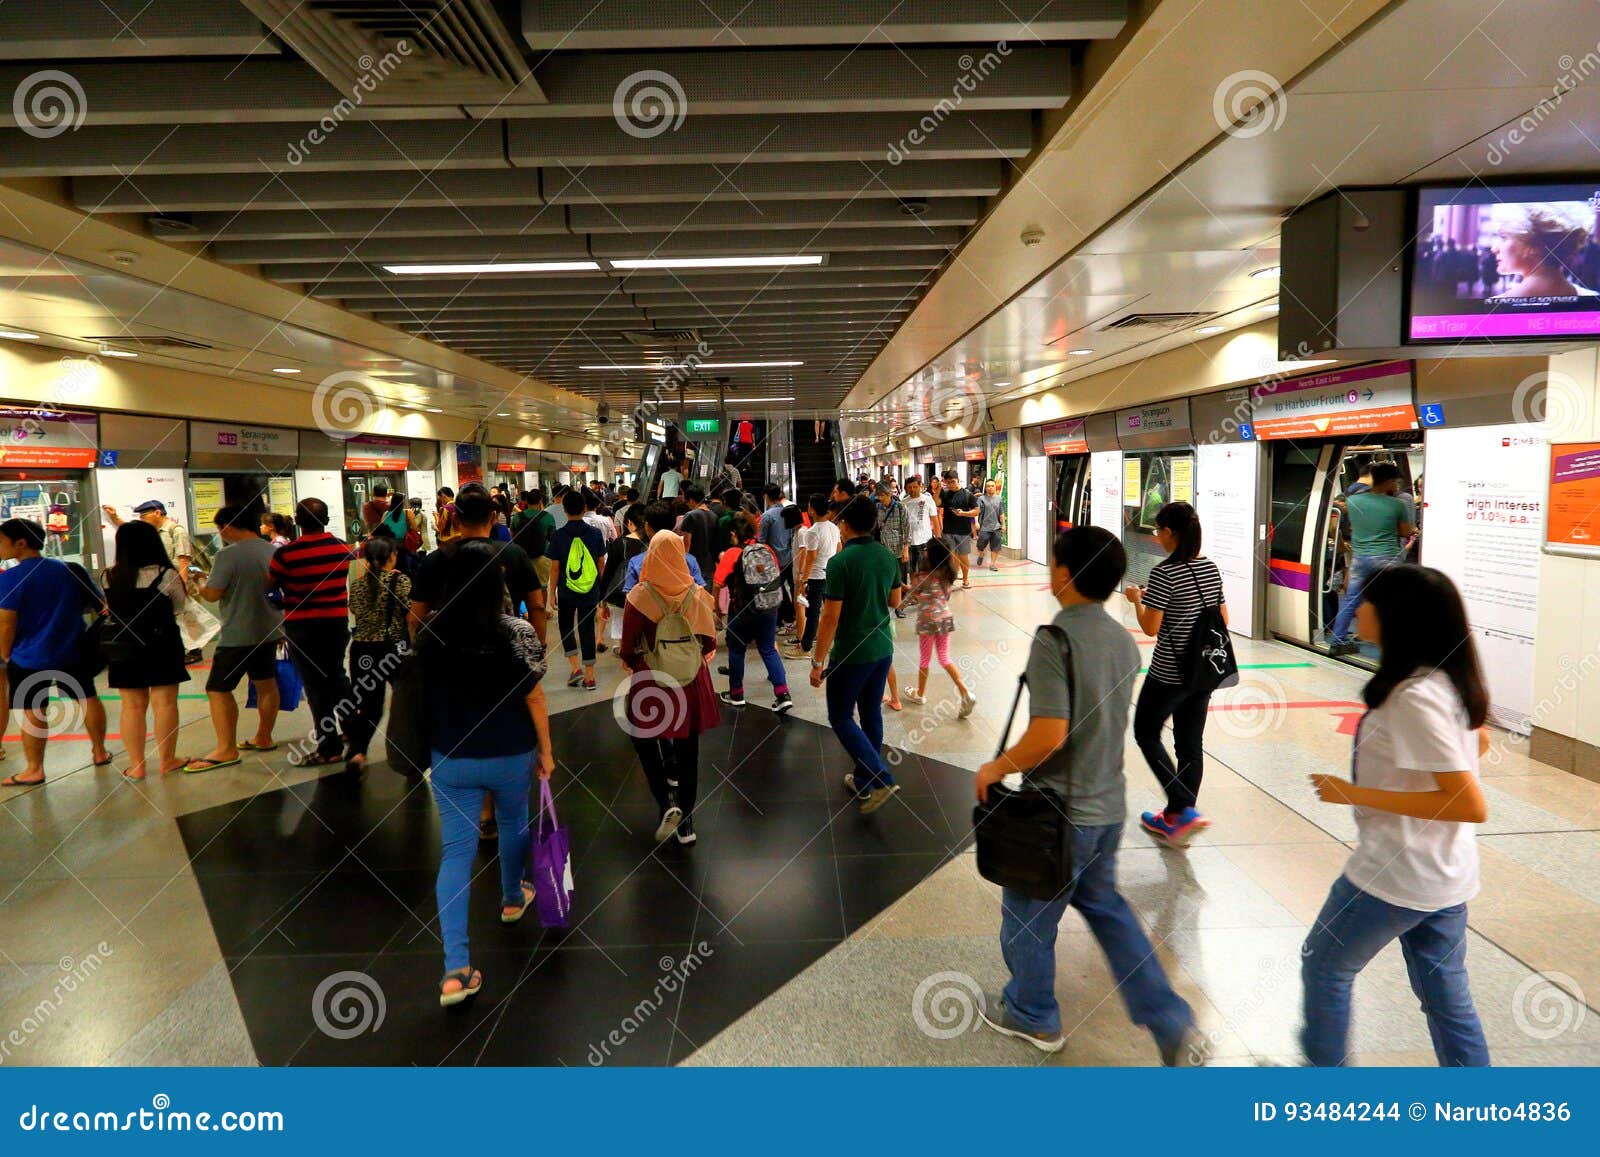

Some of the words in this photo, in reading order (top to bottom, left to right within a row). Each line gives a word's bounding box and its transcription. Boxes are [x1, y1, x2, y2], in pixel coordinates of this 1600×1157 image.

[1440, 320, 1465, 332] Train
[1298, 379, 1315, 388] North
[1316, 376, 1328, 385] East
[1328, 375, 1341, 383] Line
[1274, 403, 1283, 412] to
[1285, 395, 1345, 409] HarbourFront
[1349, 392, 1356, 402] 6
[694, 422, 711, 431] EXIT
[241, 429, 279, 440] Serangoon
[1467, 499, 1491, 510] High
[1495, 500, 1540, 511] Interest
[1466, 511, 1477, 520] of
[1481, 511, 1506, 522] 1.0%
[1509, 515, 1530, 524] p.a.
